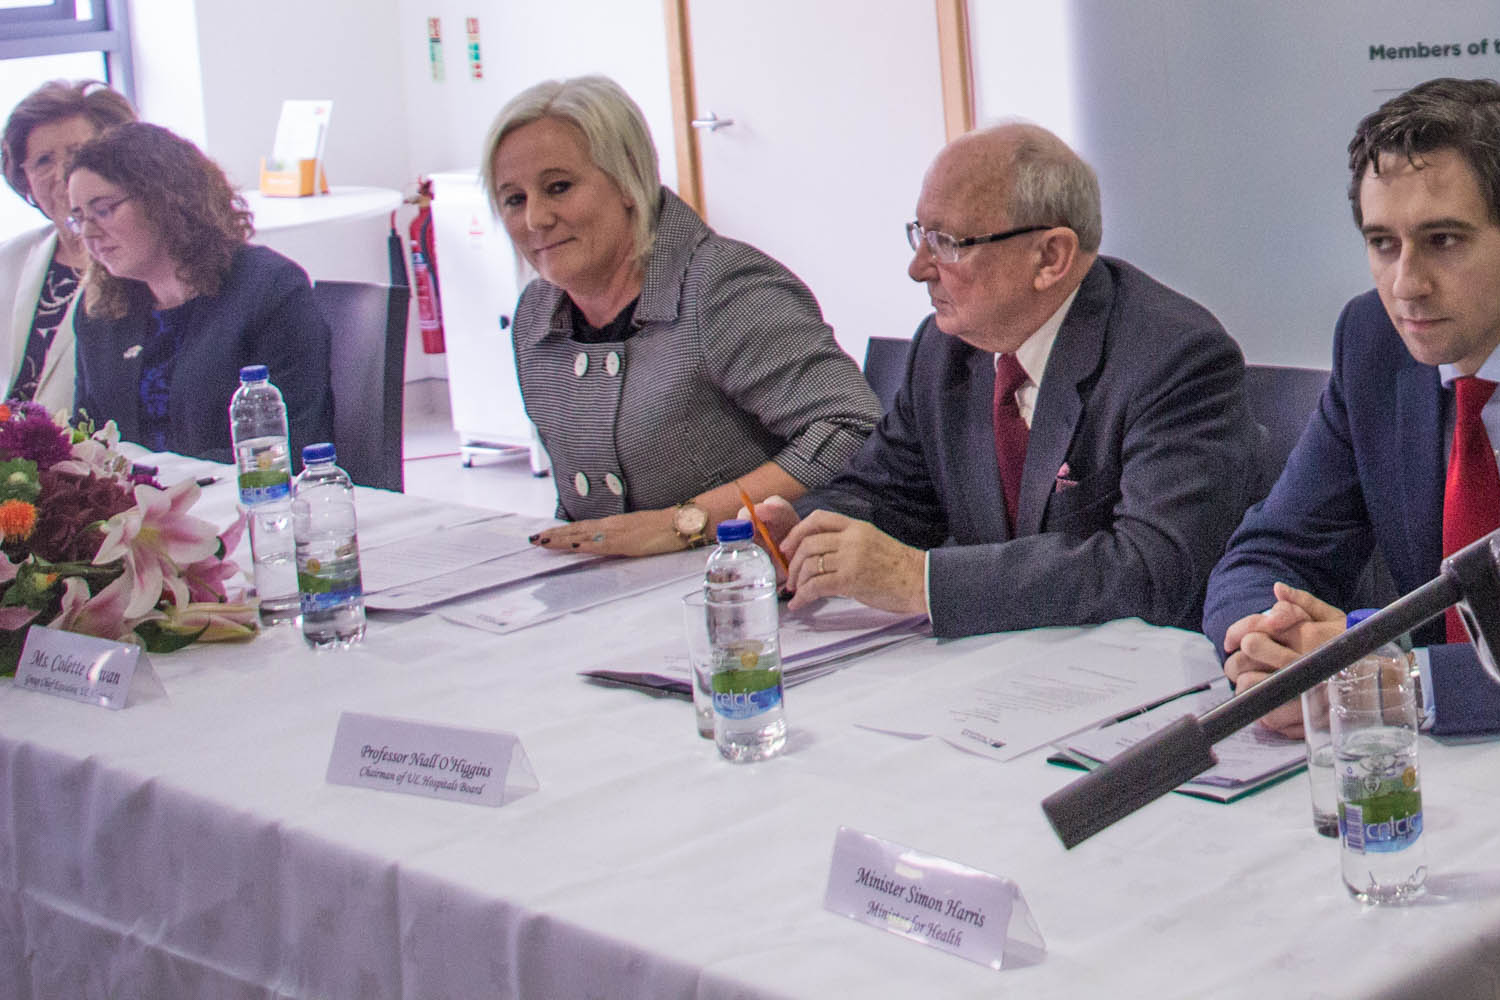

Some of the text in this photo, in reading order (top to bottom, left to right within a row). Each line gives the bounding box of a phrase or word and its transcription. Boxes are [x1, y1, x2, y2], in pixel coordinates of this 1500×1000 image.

[1369, 42, 1462, 60] Members
[1467, 39, 1489, 55] of
[360, 744, 408, 764] Professor
[408, 752, 439, 769] Niall
[359, 766, 395, 781] Chairman
[855, 867, 986, 928] Minister Simon Harris
[925, 921, 963, 947] Health
